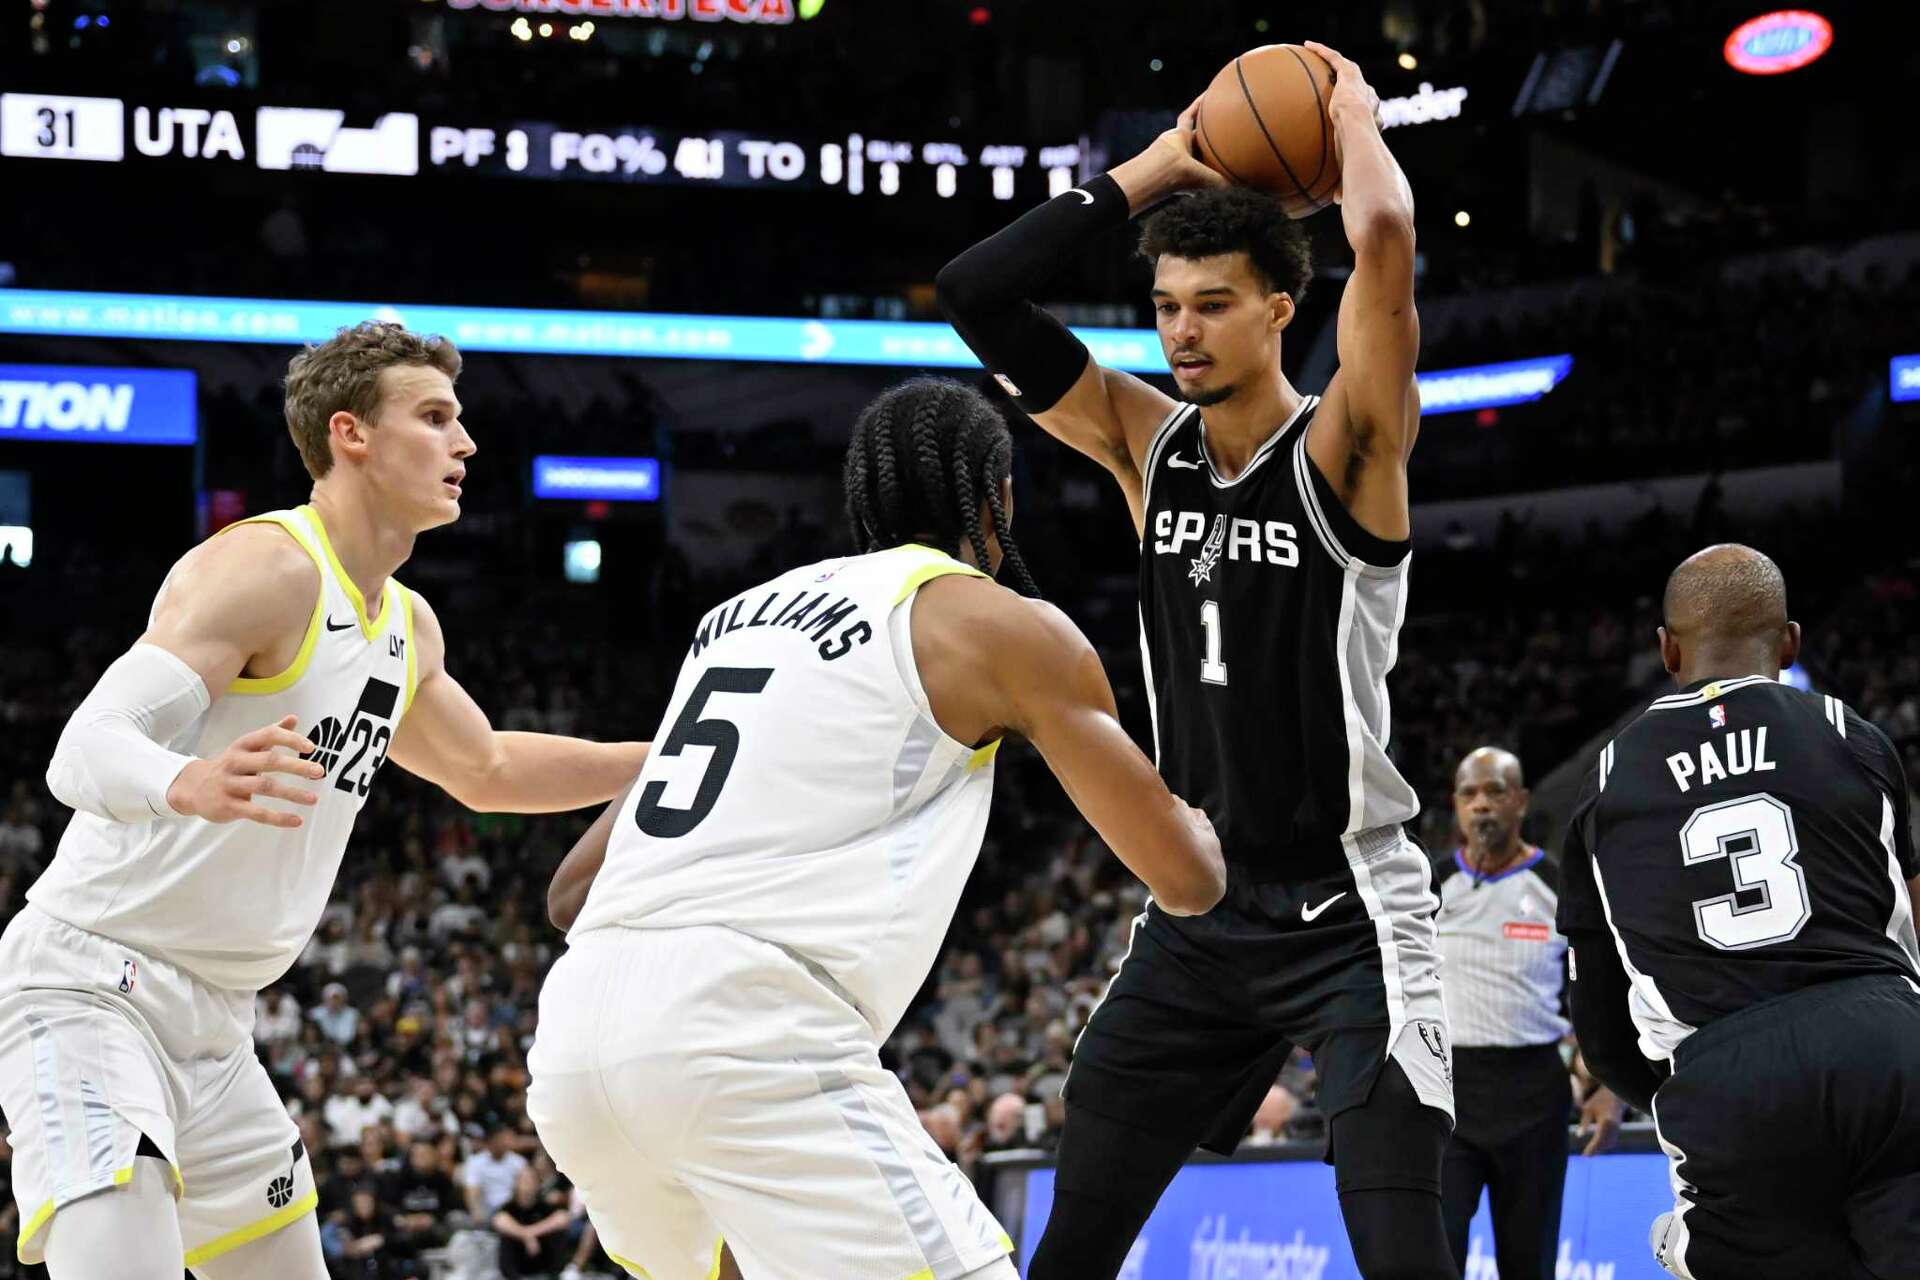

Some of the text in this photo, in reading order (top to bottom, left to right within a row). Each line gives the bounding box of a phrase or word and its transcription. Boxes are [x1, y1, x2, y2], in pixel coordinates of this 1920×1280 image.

[36, 107, 75, 148] 31
[134, 105, 246, 160] UTA
[431, 126, 495, 167] PF
[737, 139, 806, 182] TO
[691, 590, 873, 662] WILLIAMS
[1199, 599, 1229, 687] 1
[334, 717, 392, 798] 23
[634, 666, 776, 839] 5
[1665, 726, 1777, 793] PAUL
[1678, 791, 1813, 952] 3
